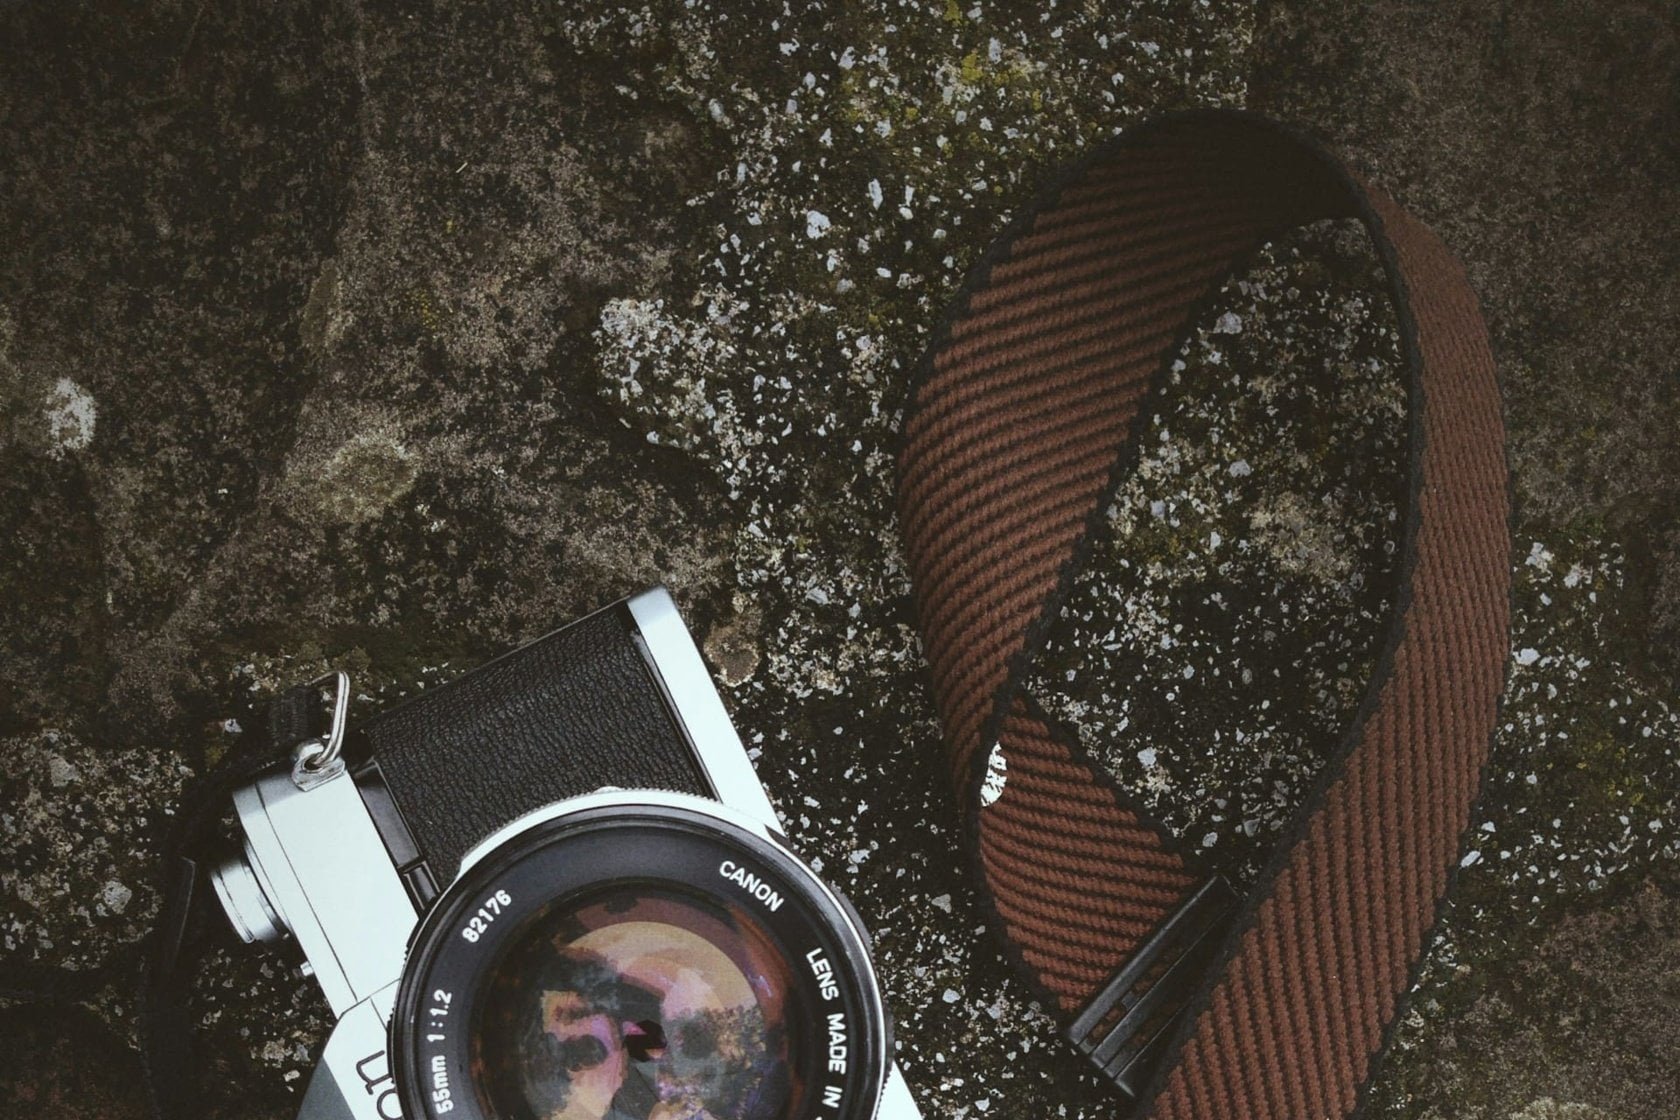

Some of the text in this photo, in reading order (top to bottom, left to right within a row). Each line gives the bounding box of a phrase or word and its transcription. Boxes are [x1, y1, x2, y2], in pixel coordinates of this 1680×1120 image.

[719, 860, 784, 912] CANON
[462, 889, 512, 943] 82176
[806, 947, 839, 1001] LENS
[826, 1013, 847, 1075] MADE
[432, 1055, 454, 1114] 55mm
[822, 1085, 843, 1108] IN
